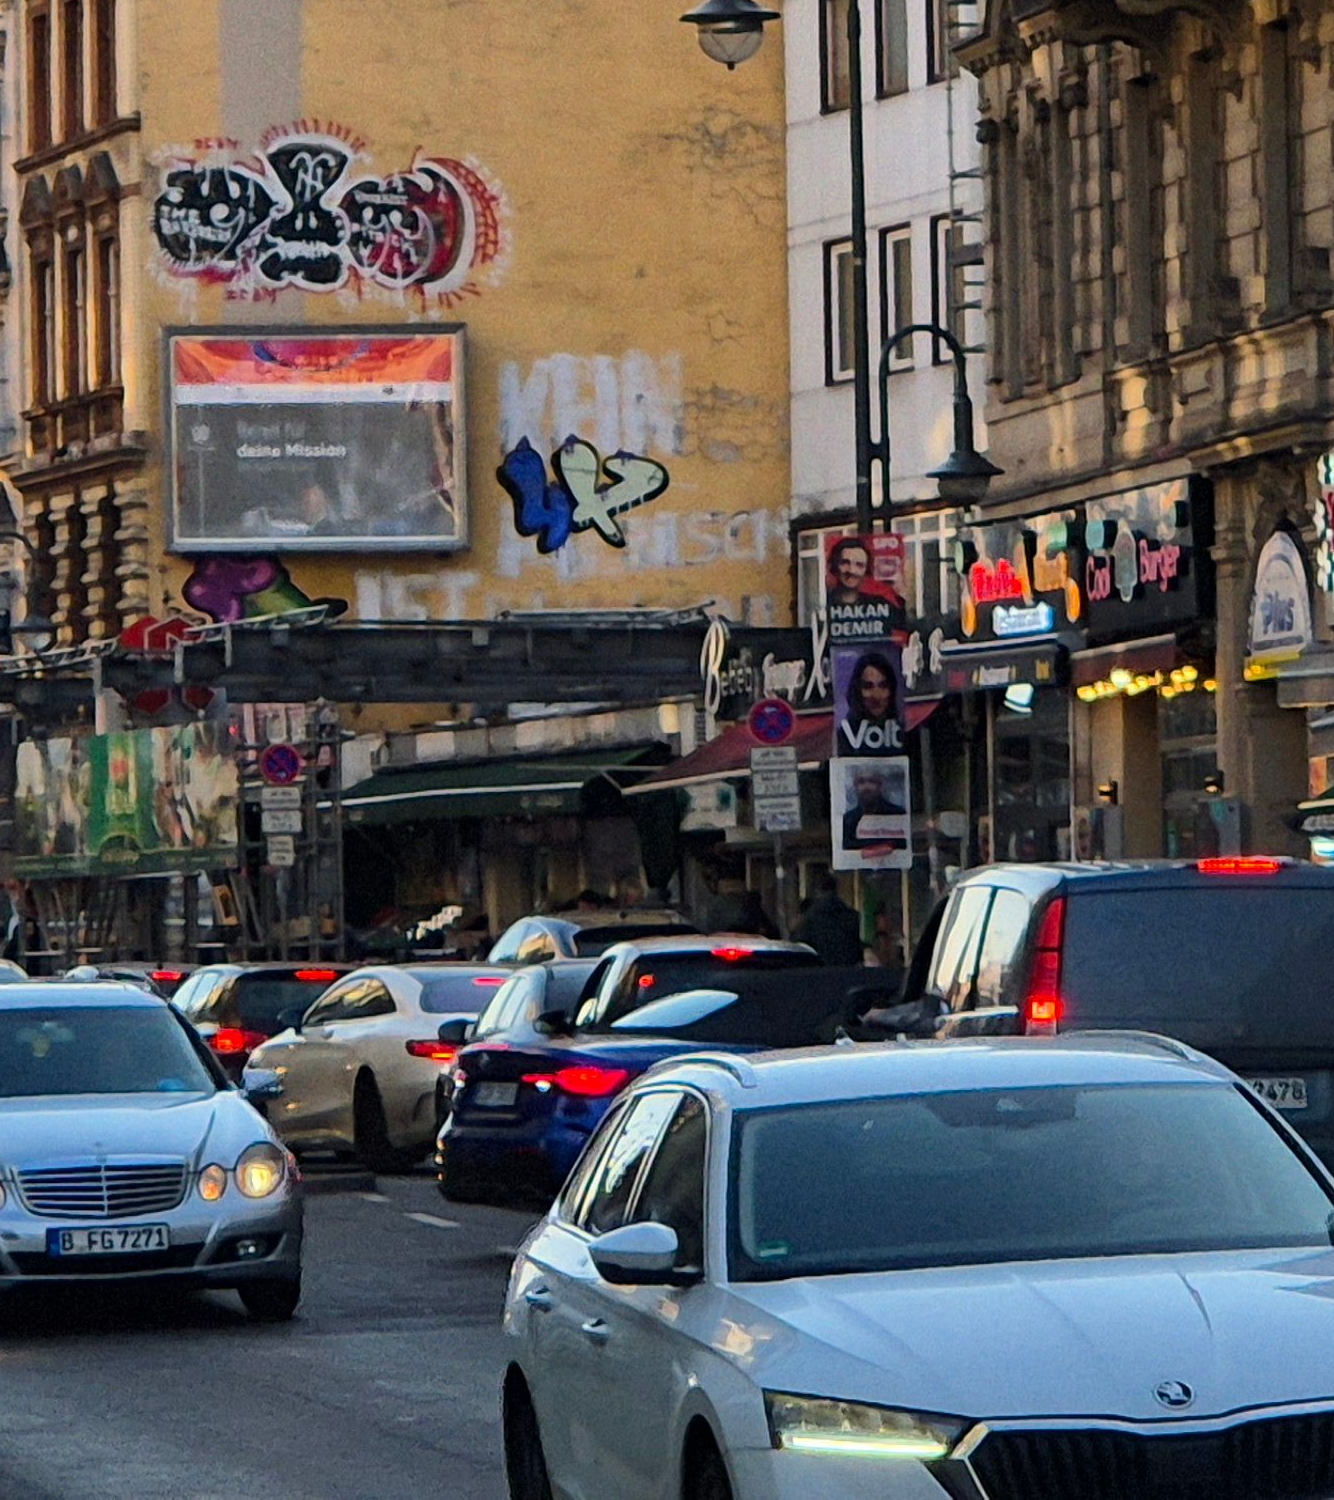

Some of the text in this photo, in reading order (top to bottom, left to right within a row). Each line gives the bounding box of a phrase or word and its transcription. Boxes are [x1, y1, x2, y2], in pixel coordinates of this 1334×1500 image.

[831, 604, 889, 619] HAKAN
[831, 621, 883, 636] DEMIR
[841, 718, 903, 749] Volt
[61, 1227, 166, 1251] B FG 7271
